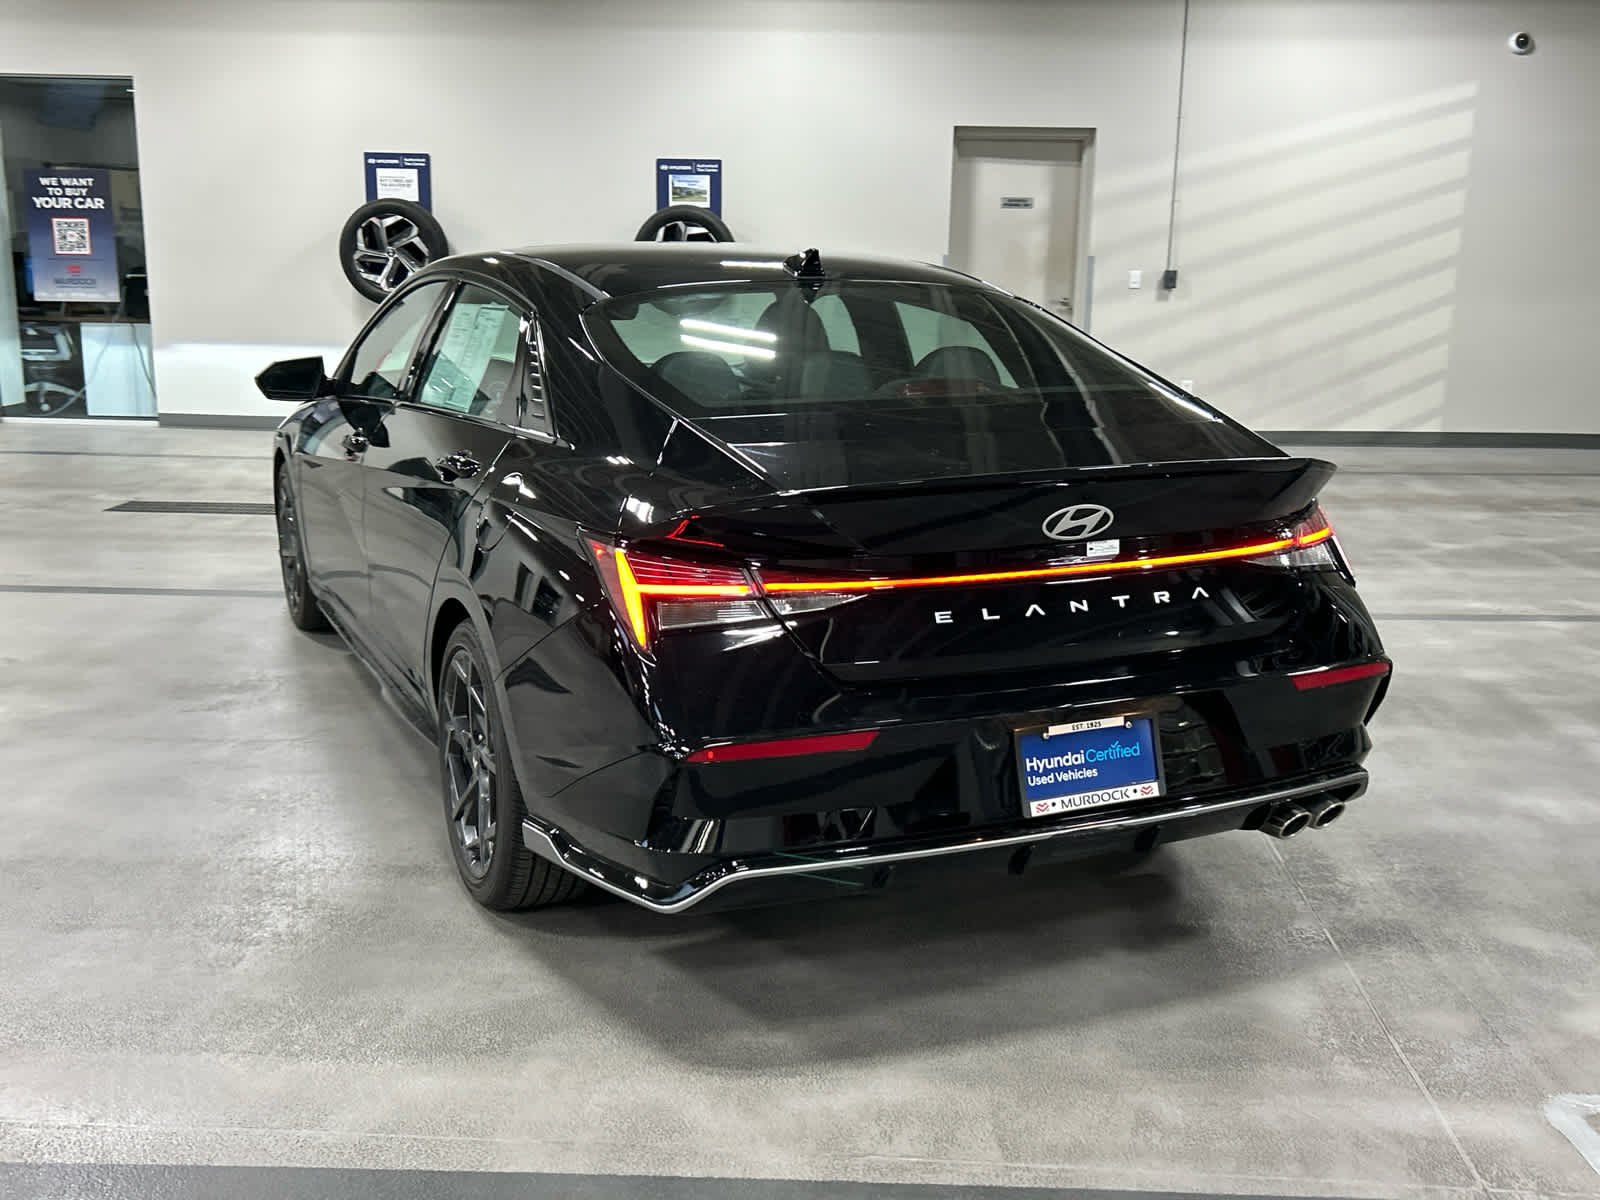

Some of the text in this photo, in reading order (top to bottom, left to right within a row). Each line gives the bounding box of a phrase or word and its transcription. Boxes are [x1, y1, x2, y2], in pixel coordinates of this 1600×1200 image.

[39, 177, 94, 187] WE WANT
[47, 187, 88, 196] TO BUY
[32, 197, 105, 209] YOUR CAR
[934, 586, 1209, 624] ELANTRA
[1026, 741, 1141, 773] Hyundai Certified
[1028, 767, 1098, 787] Used Vehicles
[1060, 788, 1131, 810] MURDOCK
